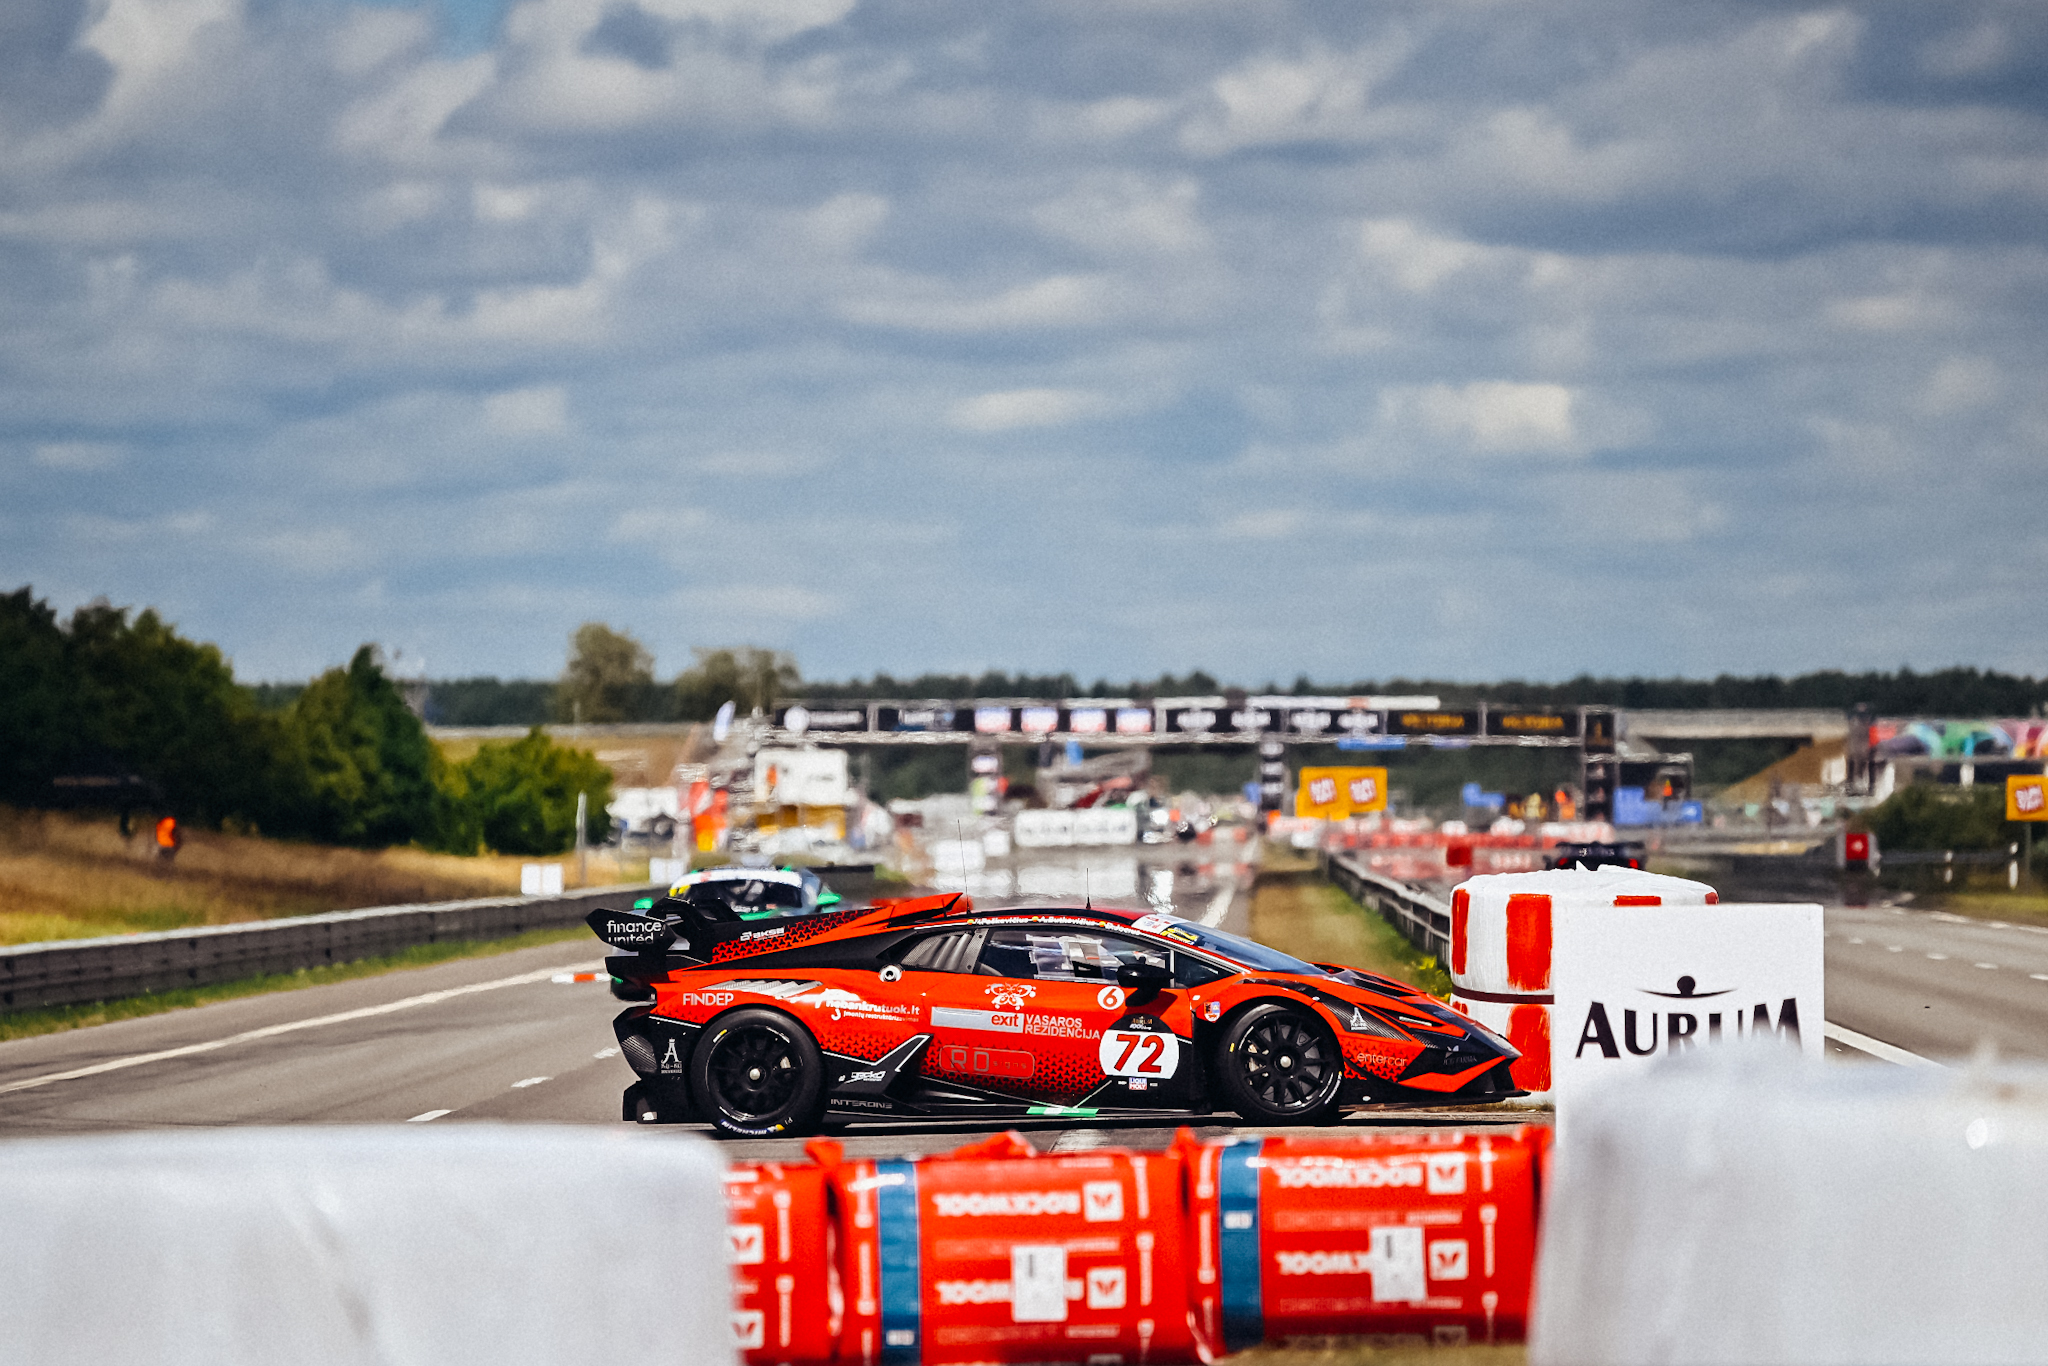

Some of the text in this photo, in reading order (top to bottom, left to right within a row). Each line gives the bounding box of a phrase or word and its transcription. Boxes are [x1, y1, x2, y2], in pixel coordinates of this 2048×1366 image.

[606, 920, 661, 933] finance
[683, 992, 735, 1006] FINDEP
[1103, 988, 1118, 1007] 6
[991, 1013, 1019, 1027] exit
[1025, 1013, 1082, 1028] VASAROS
[1025, 1024, 1100, 1040] REZIDENCIJA
[1114, 1034, 1164, 1073] 72
[1357, 1052, 1407, 1067] entercar
[830, 1098, 893, 1109] INTERONE
